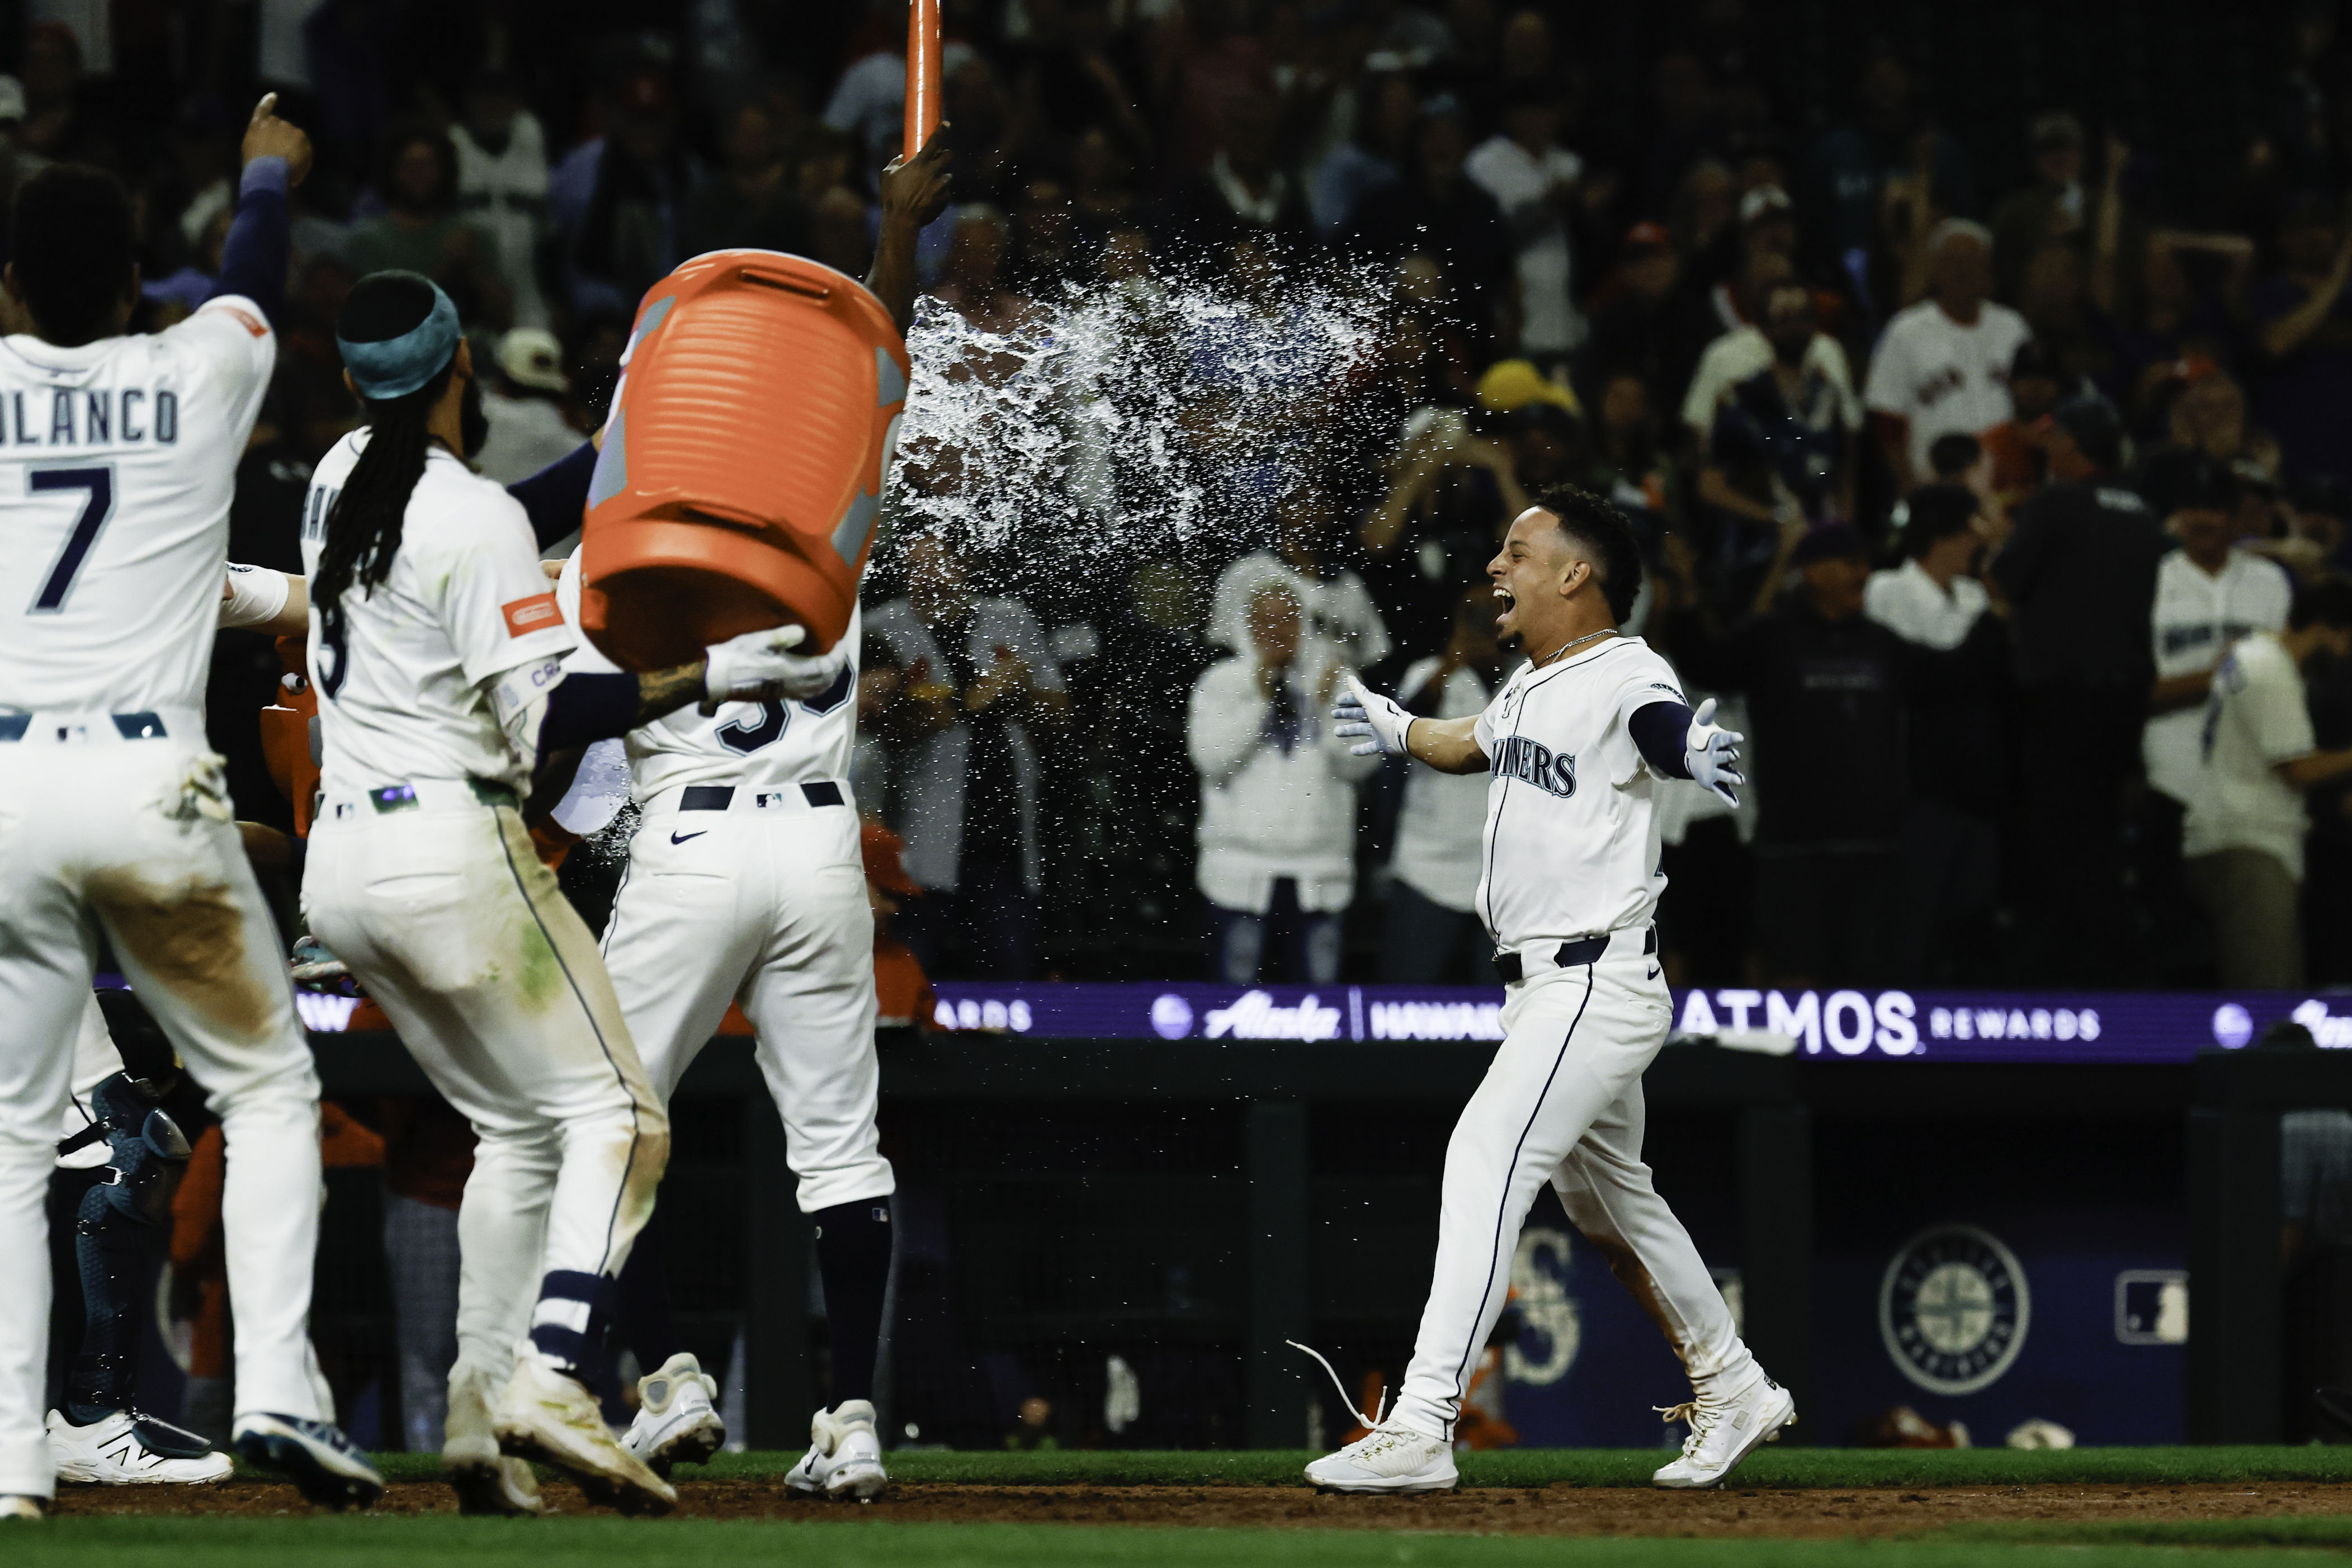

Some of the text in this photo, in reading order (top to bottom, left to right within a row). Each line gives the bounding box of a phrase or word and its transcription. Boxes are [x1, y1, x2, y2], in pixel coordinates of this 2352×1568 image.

[0, 390, 178, 446] LANCO
[23, 461, 119, 616] 7
[1679, 989, 2101, 1055] ATMOS REWARDS
